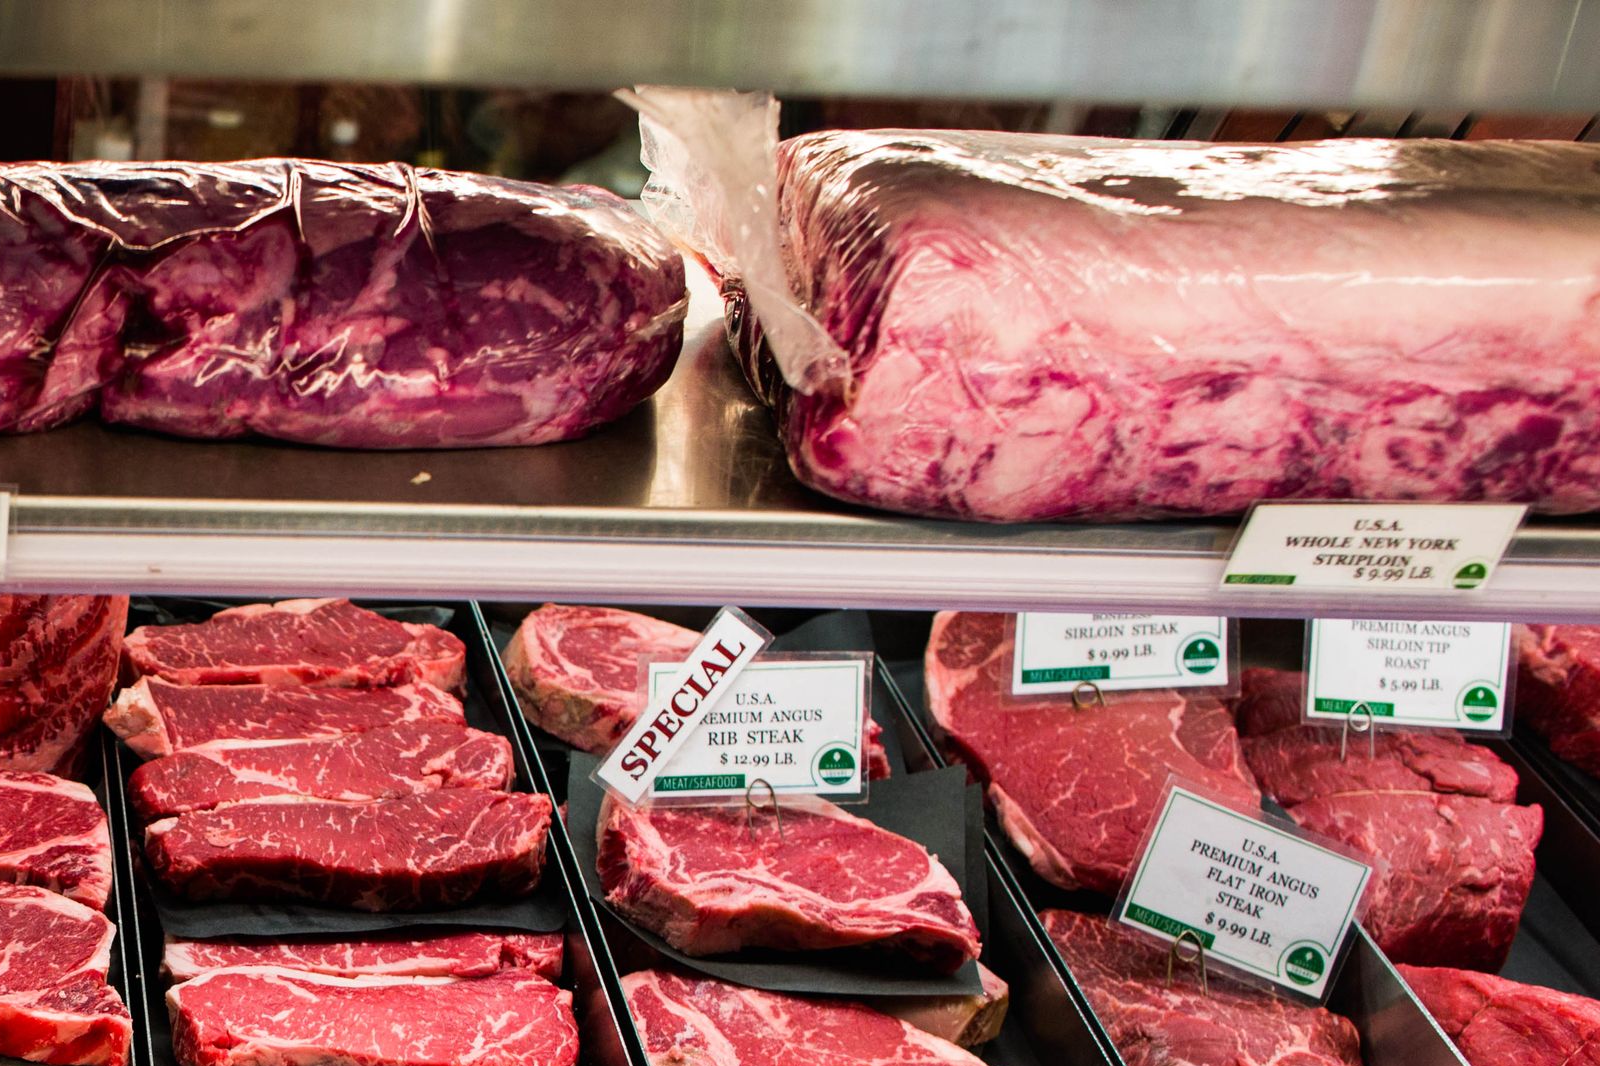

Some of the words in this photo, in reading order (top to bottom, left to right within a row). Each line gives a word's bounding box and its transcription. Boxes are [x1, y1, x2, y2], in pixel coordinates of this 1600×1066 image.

[1353, 519, 1404, 532] U.S.A.
[1285, 536, 1351, 548] WHOLE
[1359, 537, 1400, 549] NEW
[1406, 538, 1459, 551] YORK
[1313, 554, 1412, 567] STRIPLOIN
[1354, 566, 1363, 579] $
[1369, 569, 1404, 582] 9.99
[1065, 626, 1124, 640] SIRLOIN
[1132, 623, 1179, 636] STEAK
[1351, 620, 1417, 635] PREMIUM
[1420, 623, 1471, 637] ANGUS
[1088, 649, 1095, 661] $
[1099, 648, 1129, 660] 9.99
[1134, 645, 1156, 657] LB.
[1367, 638, 1424, 652] SIRLOIN
[1426, 641, 1450, 654] TIP
[1384, 657, 1431, 670] ROAST
[1379, 677, 1386, 689] $
[1390, 679, 1417, 692] 5.99
[1421, 678, 1443, 691] LB.
[736, 693, 777, 705] U.S.A.
[620, 638, 746, 781] SPECIAL
[699, 711, 762, 725] REMIUM
[770, 709, 823, 722] ANGUS
[708, 731, 738, 746] RIB
[746, 729, 804, 745] STEAK
[720, 752, 728, 765] $
[734, 754, 770, 767] 12.99
[775, 752, 797, 765] LB.
[663, 775, 737, 789] MEAT/SEAFOOD
[1241, 838, 1280, 864] U.S.A.
[1191, 839, 1263, 877] PREMIUM
[1267, 871, 1320, 899] ANGUS
[1206, 866, 1245, 890] FLAT
[1249, 882, 1289, 908] IRON
[1215, 891, 1264, 920] STEAK
[1204, 911, 1215, 926] $
[1218, 917, 1248, 939] 9.99
[1251, 927, 1273, 948] LB.
